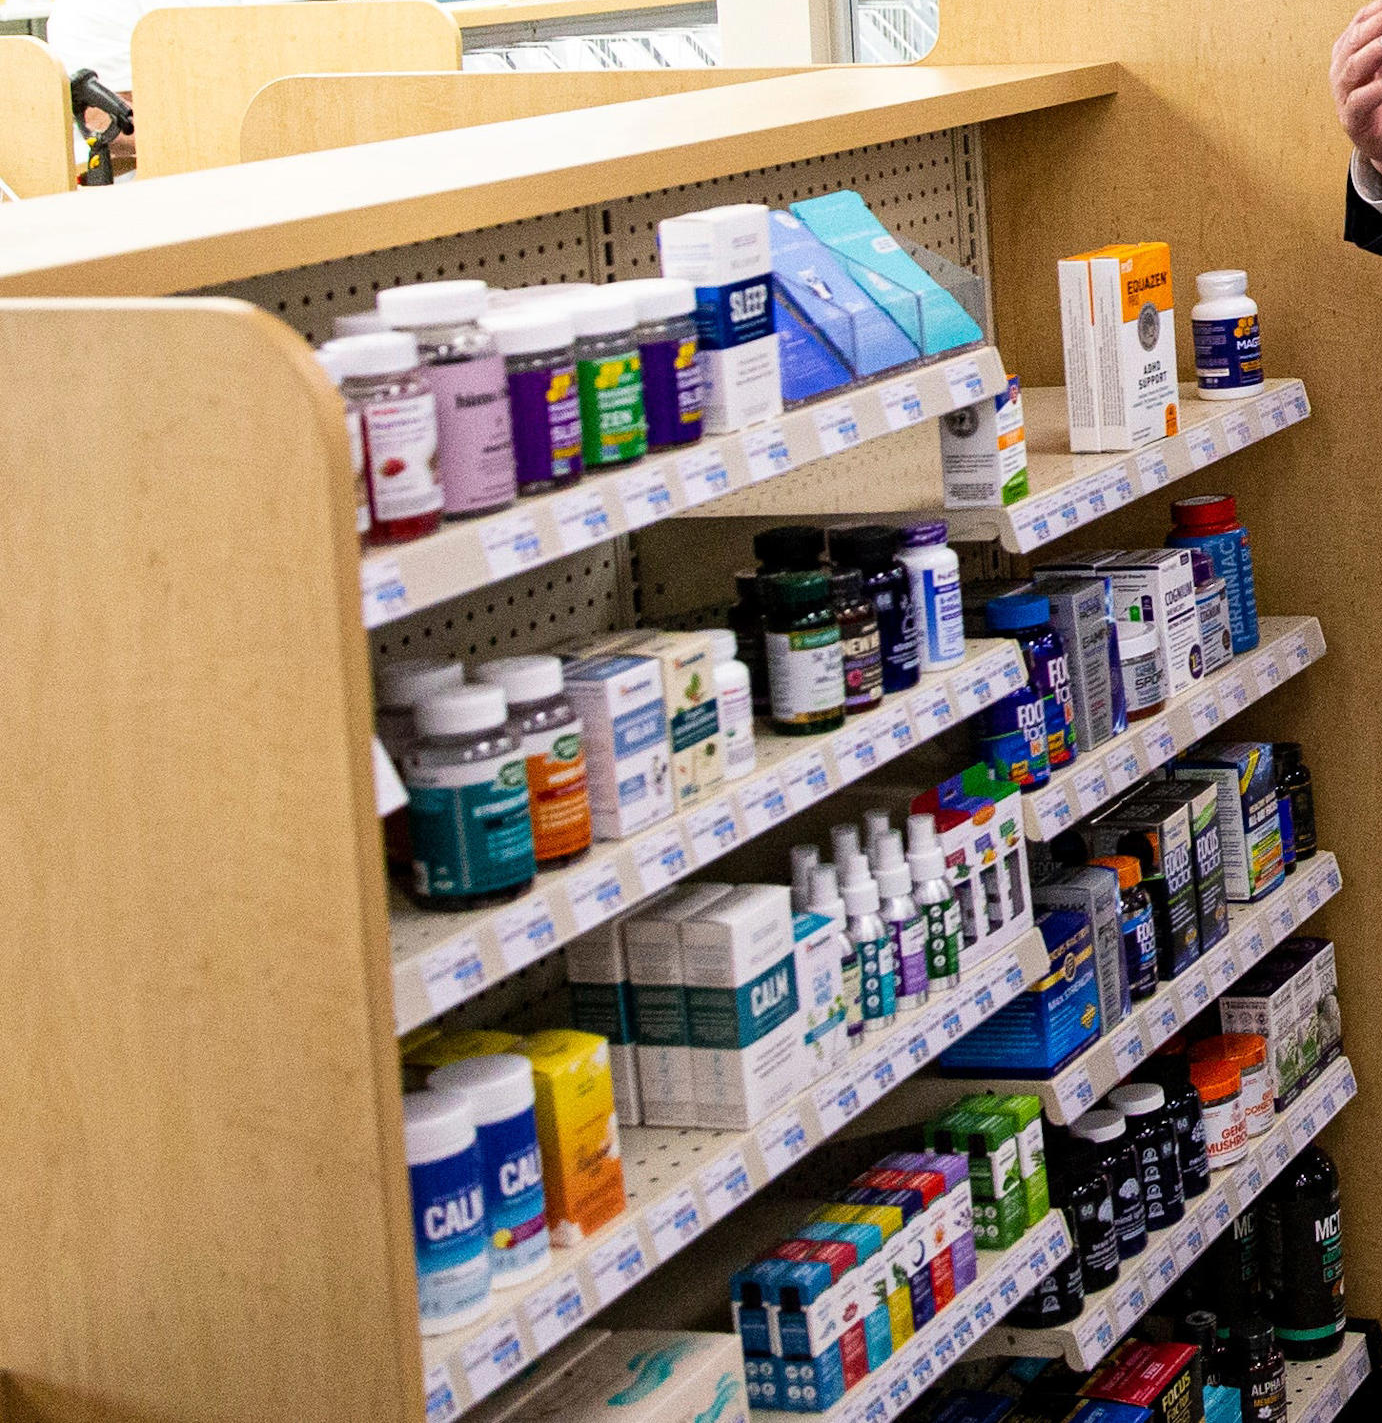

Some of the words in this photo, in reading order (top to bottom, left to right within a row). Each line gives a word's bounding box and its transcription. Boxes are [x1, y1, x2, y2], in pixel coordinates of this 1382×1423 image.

[1127, 272, 1168, 295] EQUAZEN
[729, 283, 768, 323] SLEEP
[1138, 370, 1168, 390] SUPPORT
[1219, 539, 1244, 636] BRAINIAC
[1164, 843, 1189, 879] FOCUS
[750, 967, 789, 1018] CALM
[1162, 1370, 1191, 1413] FOCUS
[1251, 1377, 1281, 1397] ALPHA
